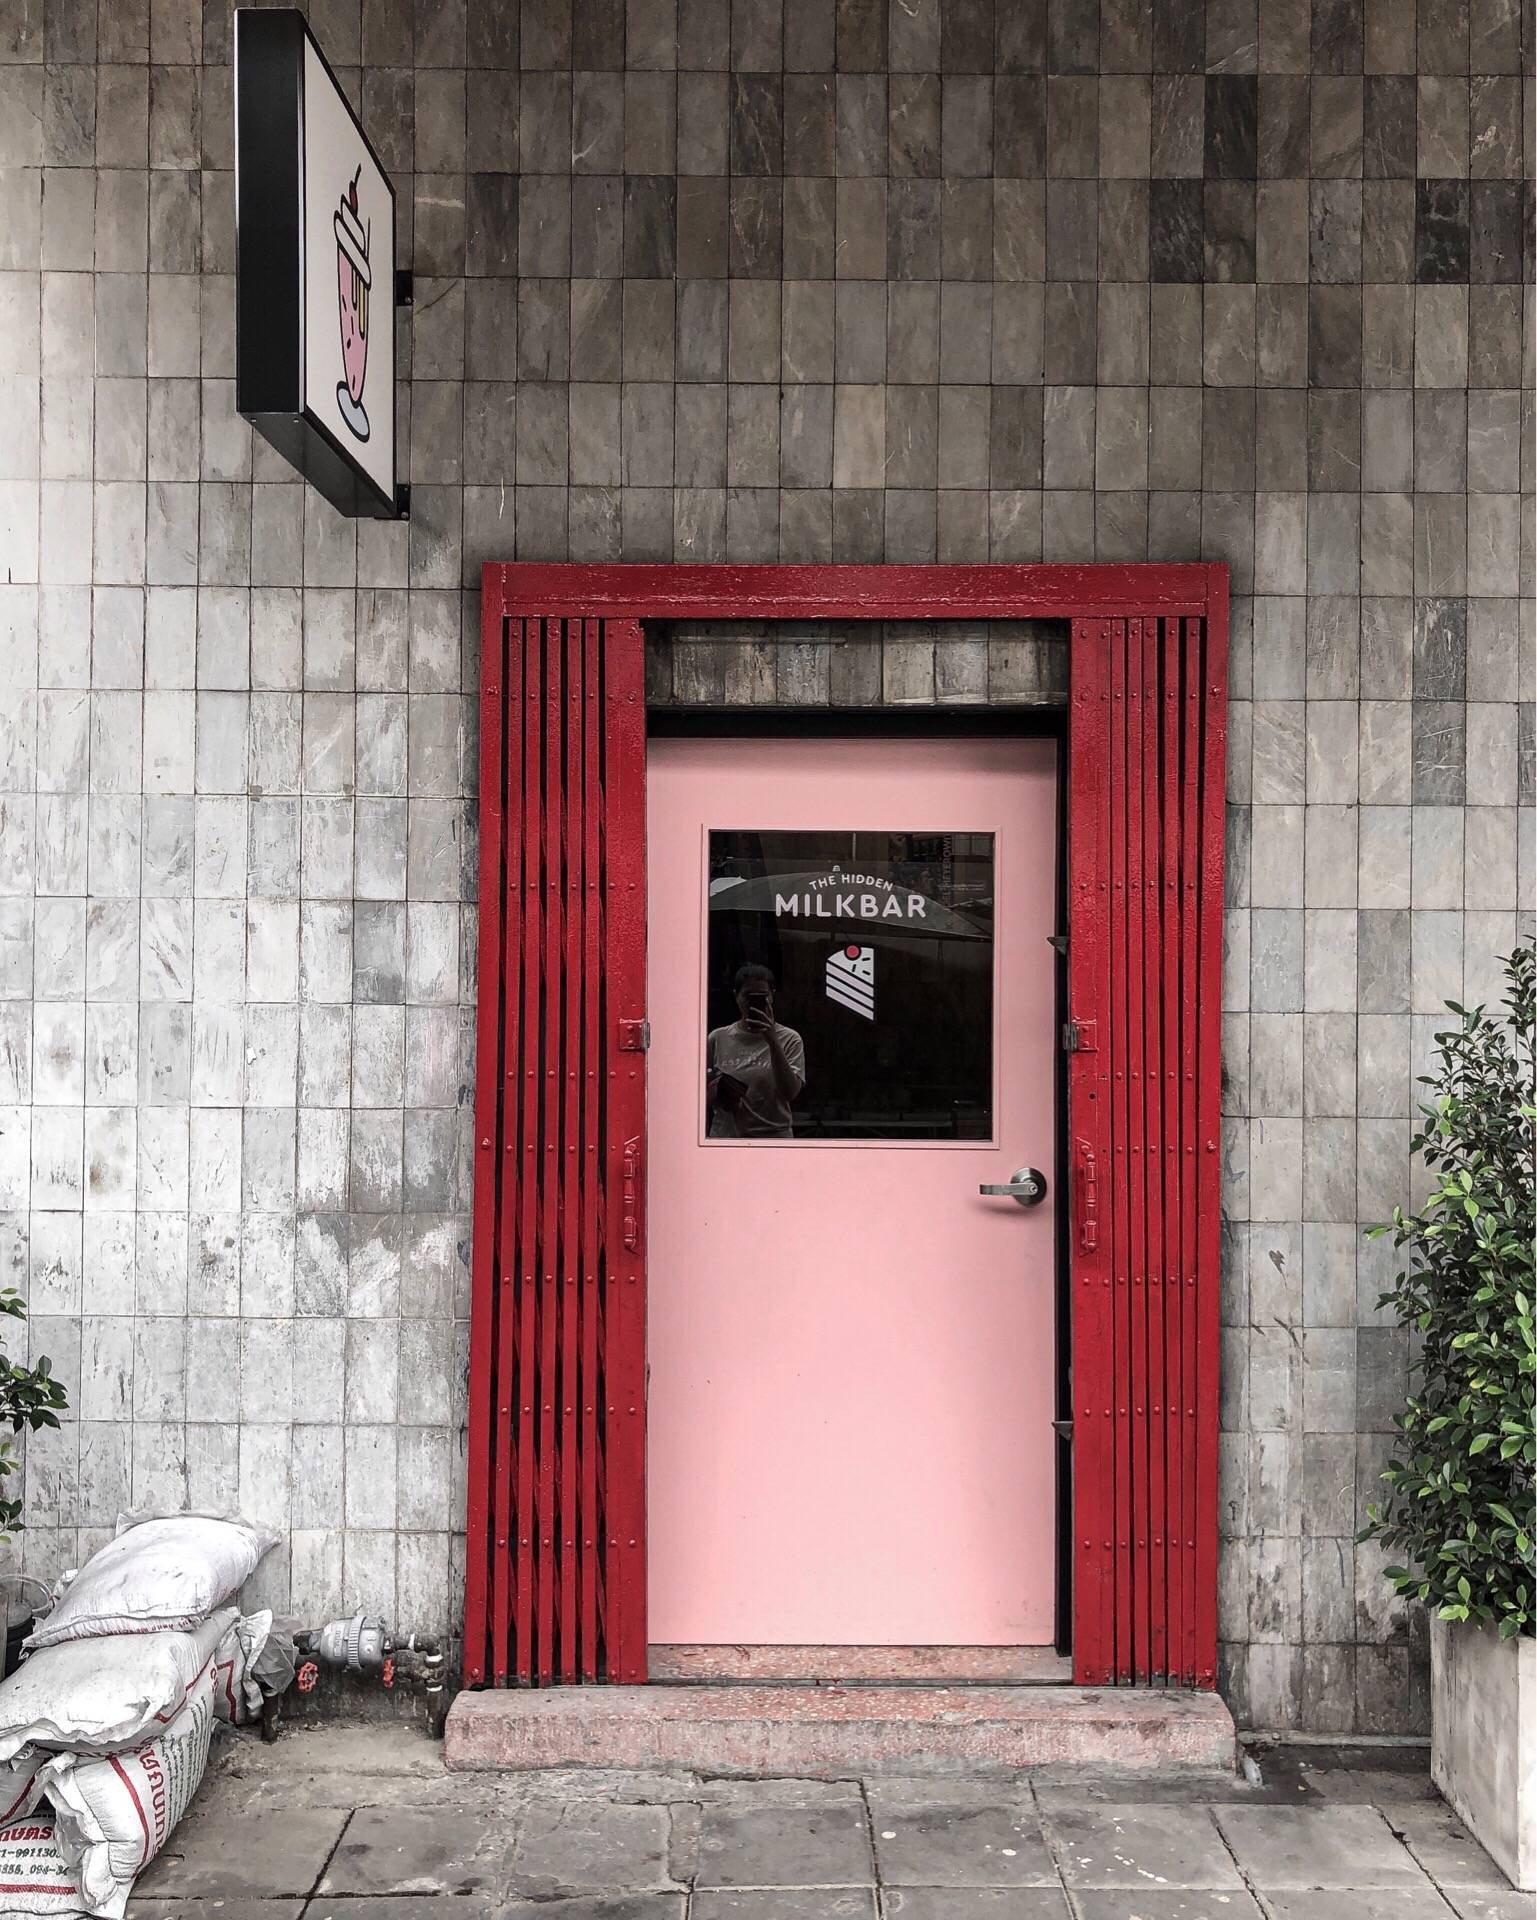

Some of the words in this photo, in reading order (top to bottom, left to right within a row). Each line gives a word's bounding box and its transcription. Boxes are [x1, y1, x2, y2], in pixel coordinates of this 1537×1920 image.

[809, 875, 836, 891] THE
[841, 874, 894, 892] HIDDEN
[775, 893, 926, 918] MILKBAR
